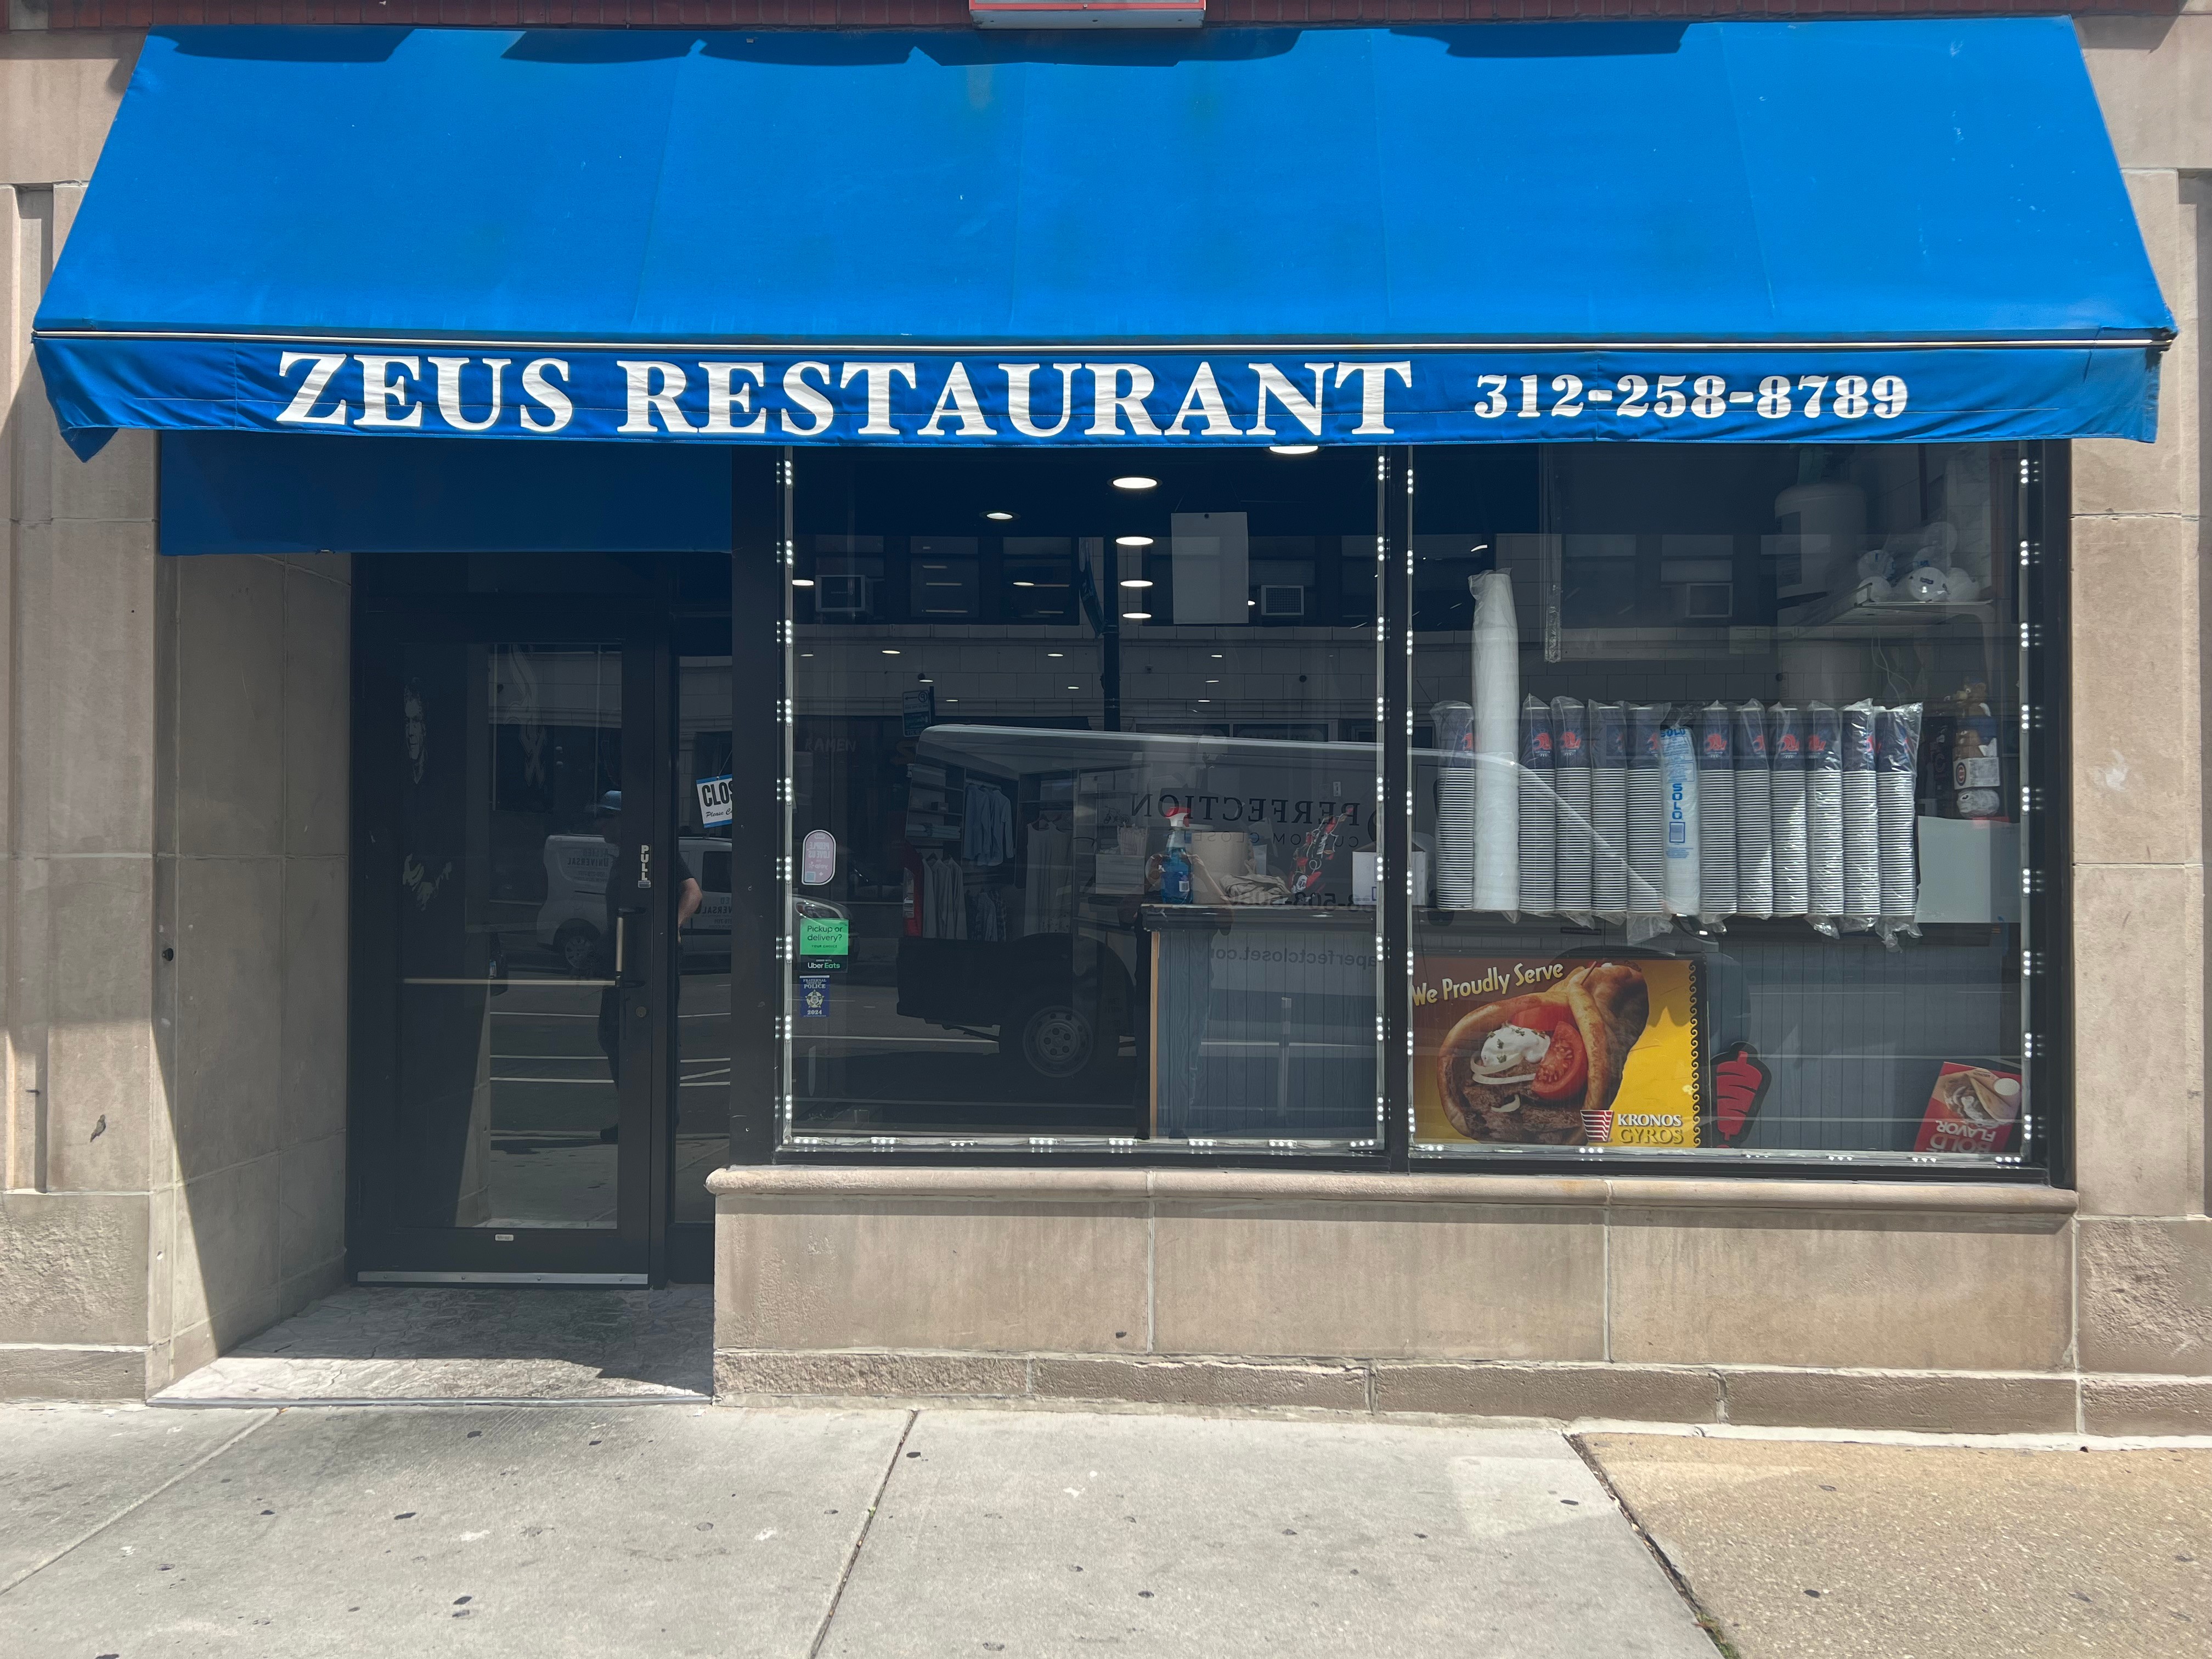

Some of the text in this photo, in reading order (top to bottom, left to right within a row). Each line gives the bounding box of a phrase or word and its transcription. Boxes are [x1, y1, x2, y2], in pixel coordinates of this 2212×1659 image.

[276, 351, 1412, 437] ZEUS RESTAURANT
[1474, 374, 1908, 419] 312-258-8789
[1671, 782, 1683, 820] SOLO
[640, 845, 650, 881] PULL
[807, 925, 833, 934] Pickup
[807, 934, 843, 943] delivery?
[1412, 963, 1564, 1006] We Proudly Serve
[1617, 1114, 1683, 1126] KRONOS
[1934, 1120, 1997, 1142] FLAVOR
[1619, 1127, 1684, 1144] GYROS
